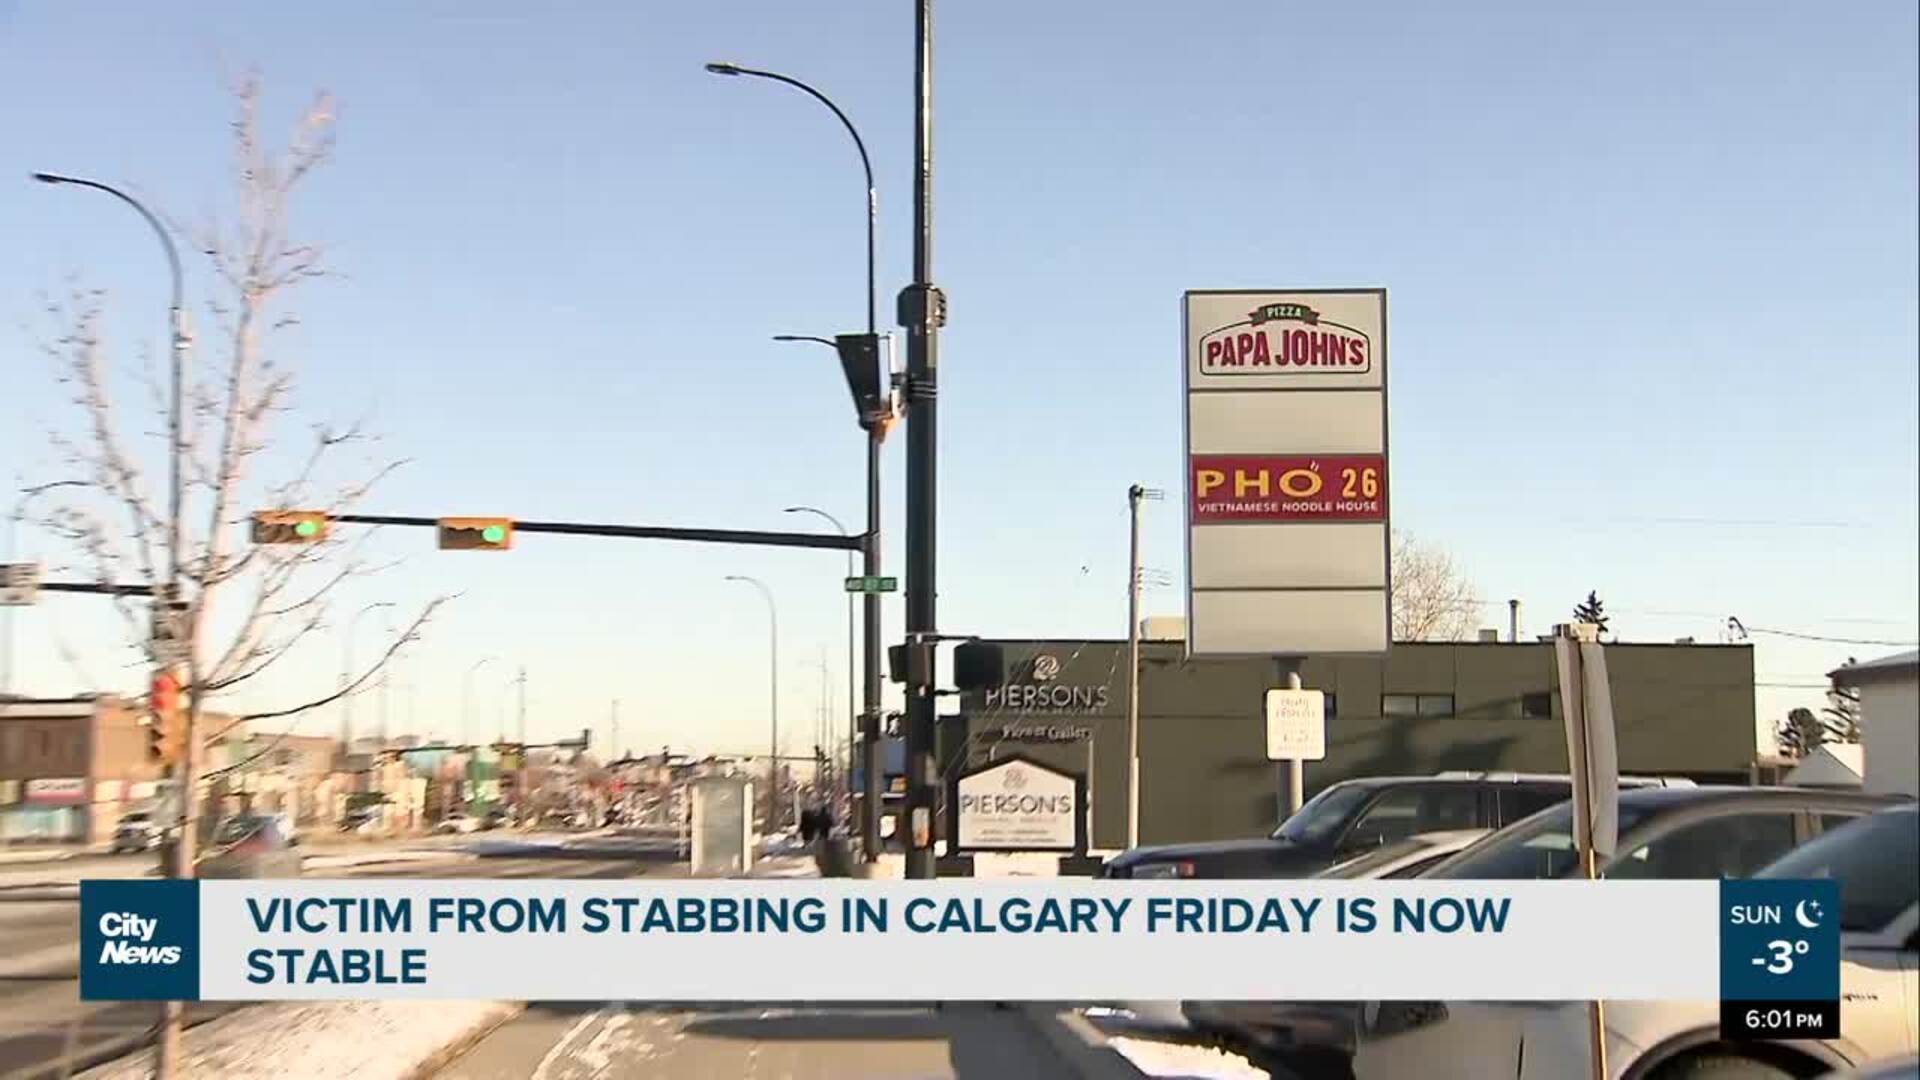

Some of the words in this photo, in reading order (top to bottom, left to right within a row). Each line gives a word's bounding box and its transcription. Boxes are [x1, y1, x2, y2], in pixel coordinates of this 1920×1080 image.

[1266, 306, 1302, 318] PIZZA
[1207, 331, 1272, 367] PAPA
[1274, 329, 1365, 367] JOHN'S
[1341, 467, 1377, 499] 26
[1198, 502, 1279, 513] VIETNAMESE
[1281, 502, 1332, 512] NOODLE
[1335, 501, 1378, 512] HOUSE
[961, 794, 1073, 815] PIERSON'S
